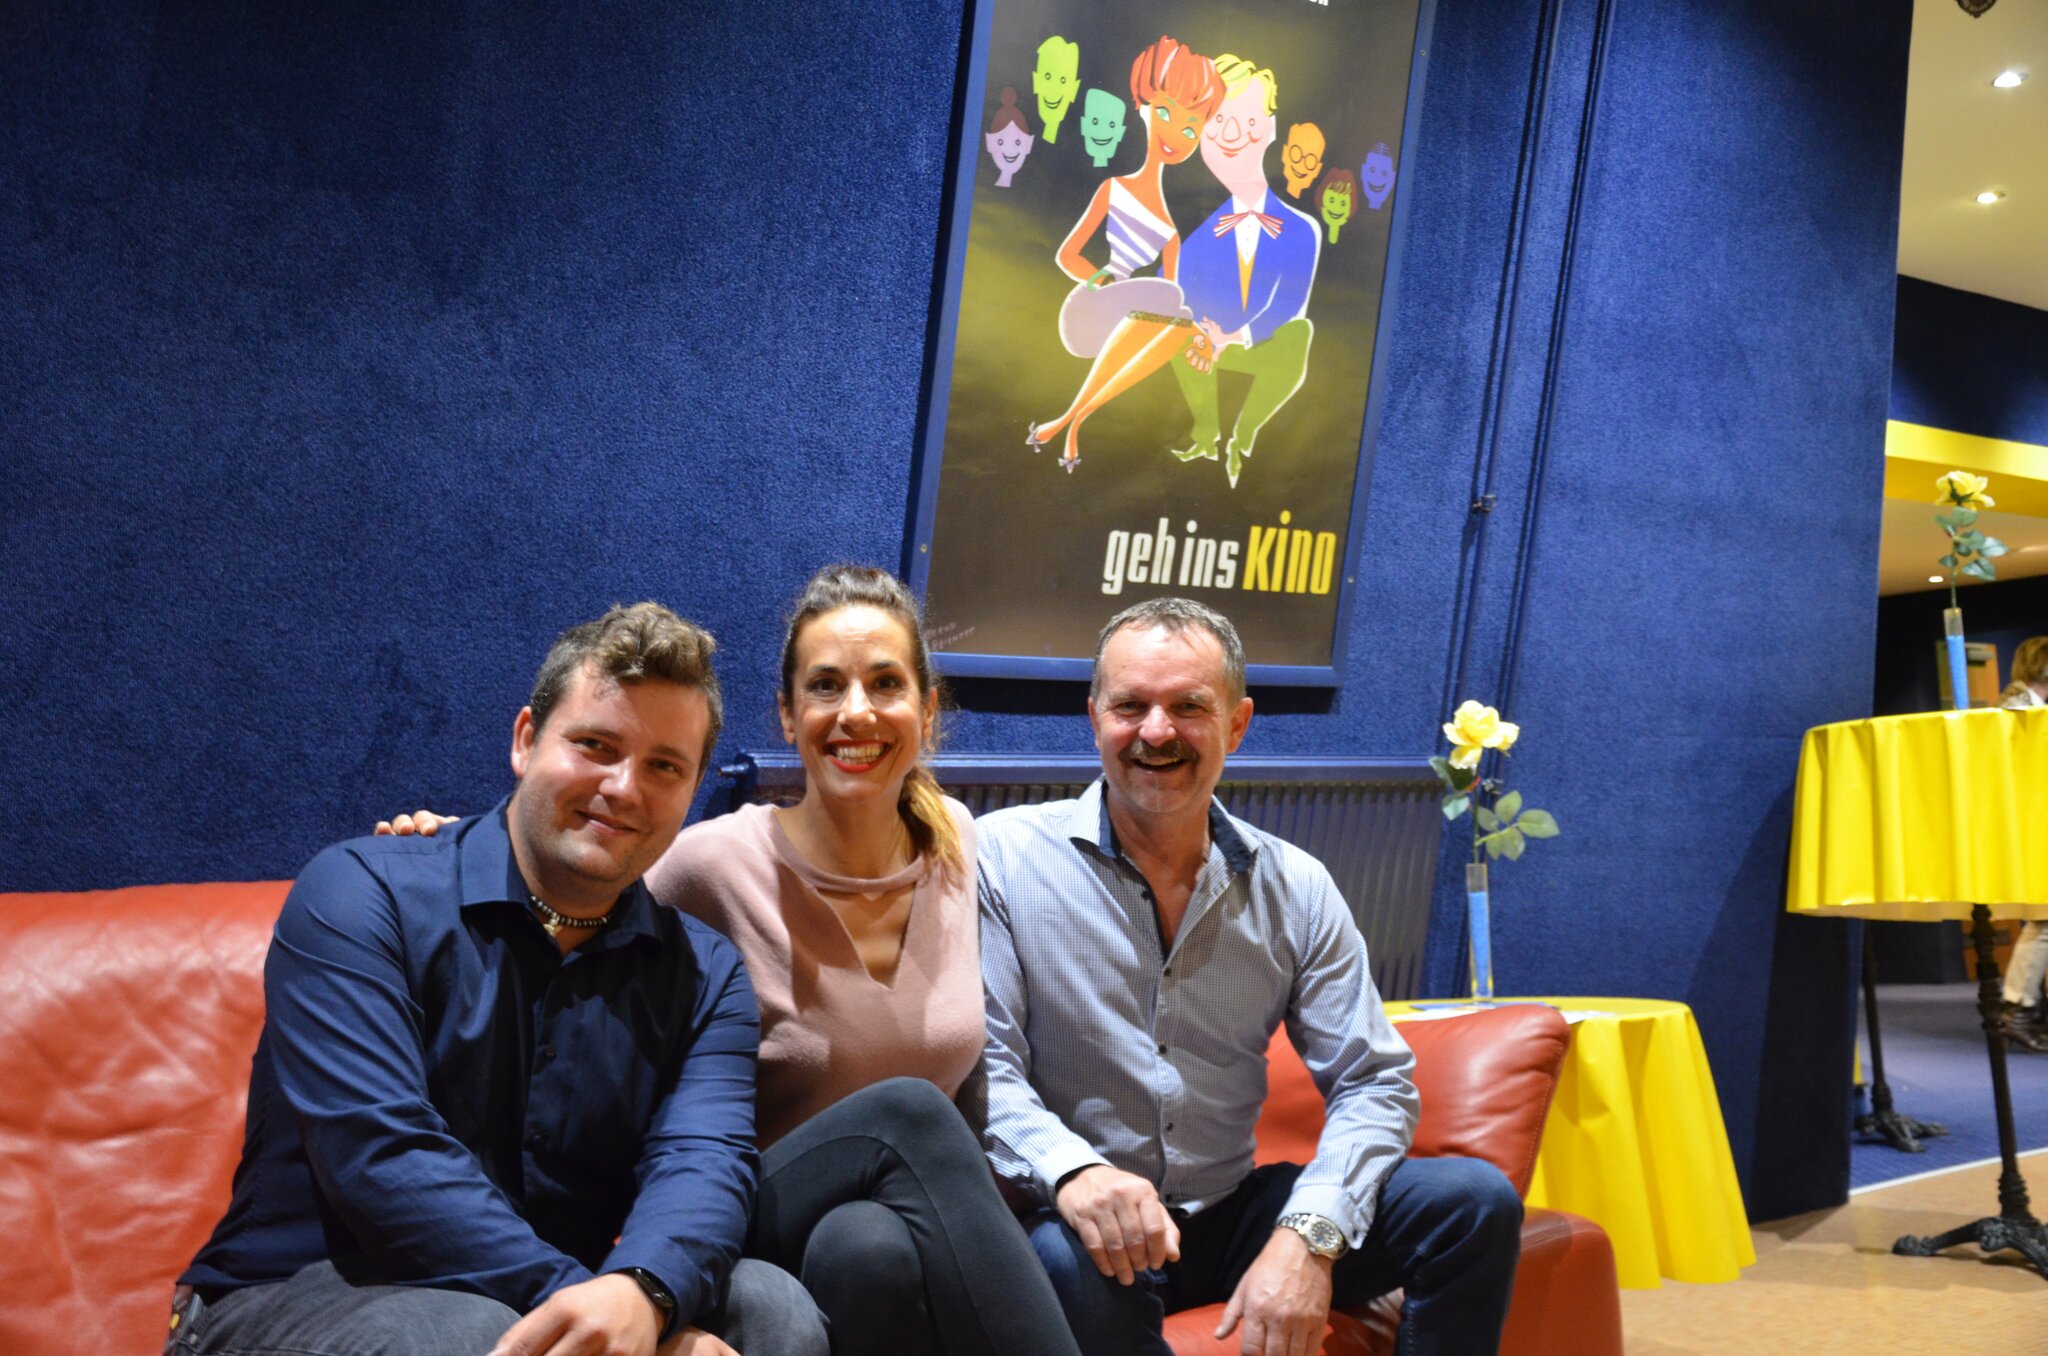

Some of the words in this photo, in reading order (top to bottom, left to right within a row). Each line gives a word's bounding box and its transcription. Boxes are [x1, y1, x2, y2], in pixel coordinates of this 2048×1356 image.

[1101, 517, 1176, 595] geh
[1178, 520, 1239, 589] ins
[1242, 509, 1337, 595] Kino
